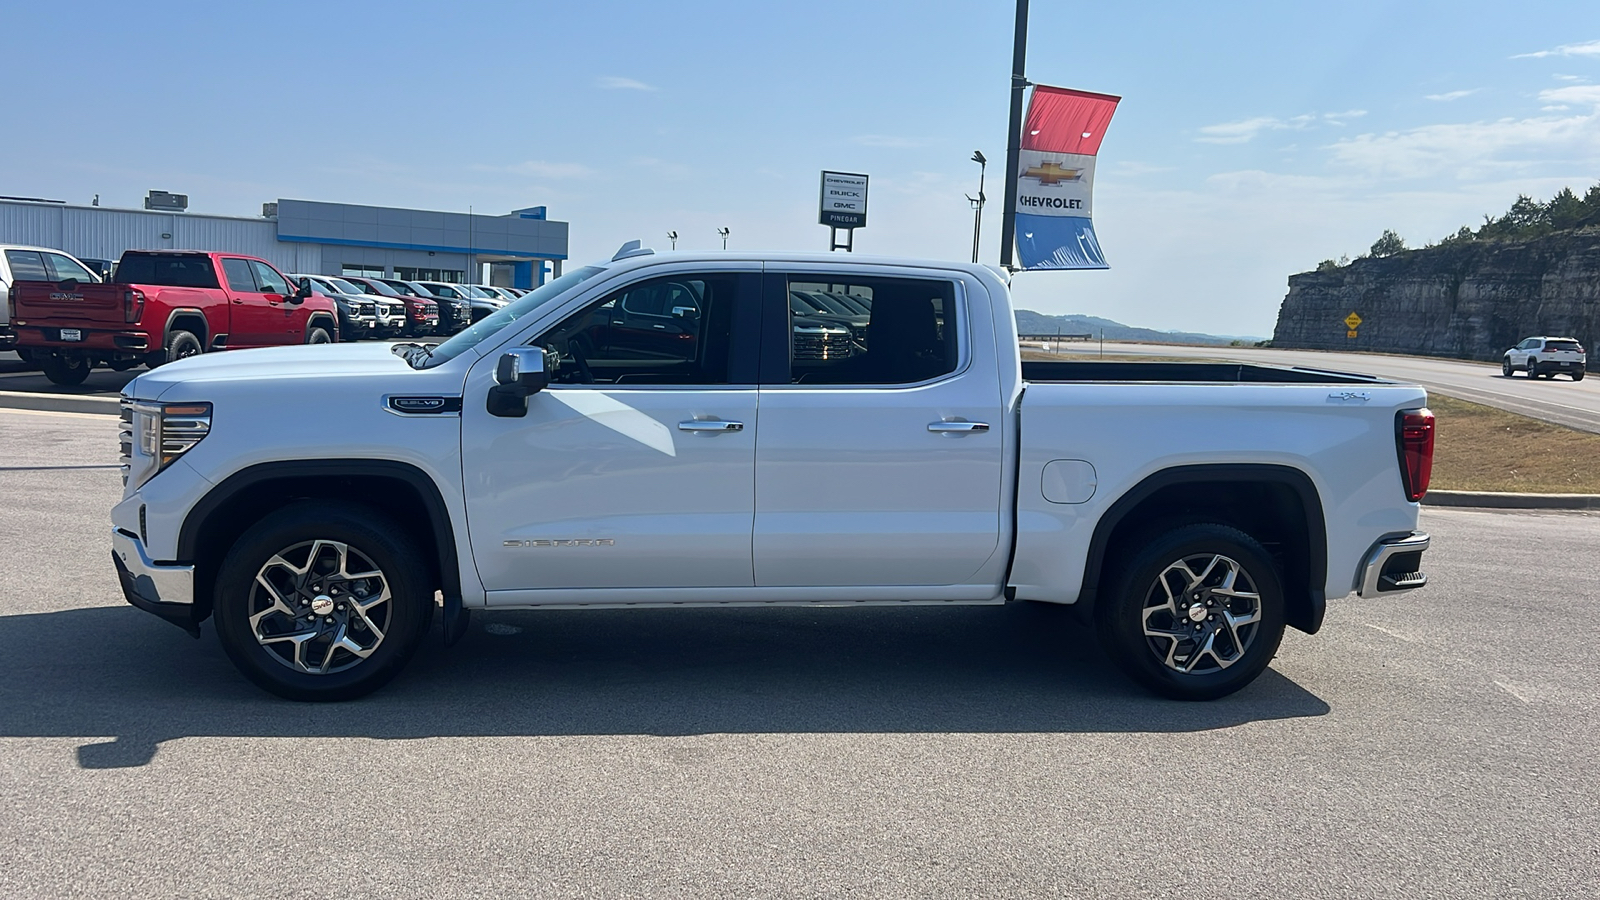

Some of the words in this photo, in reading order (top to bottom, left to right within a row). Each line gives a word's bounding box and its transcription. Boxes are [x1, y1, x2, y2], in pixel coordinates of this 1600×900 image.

[830, 190, 860, 198] BUICK
[830, 214, 858, 223] PINEGAR
[50, 292, 84, 301] GMC
[503, 539, 615, 547] SIERRA
[313, 600, 332, 611] GMC
